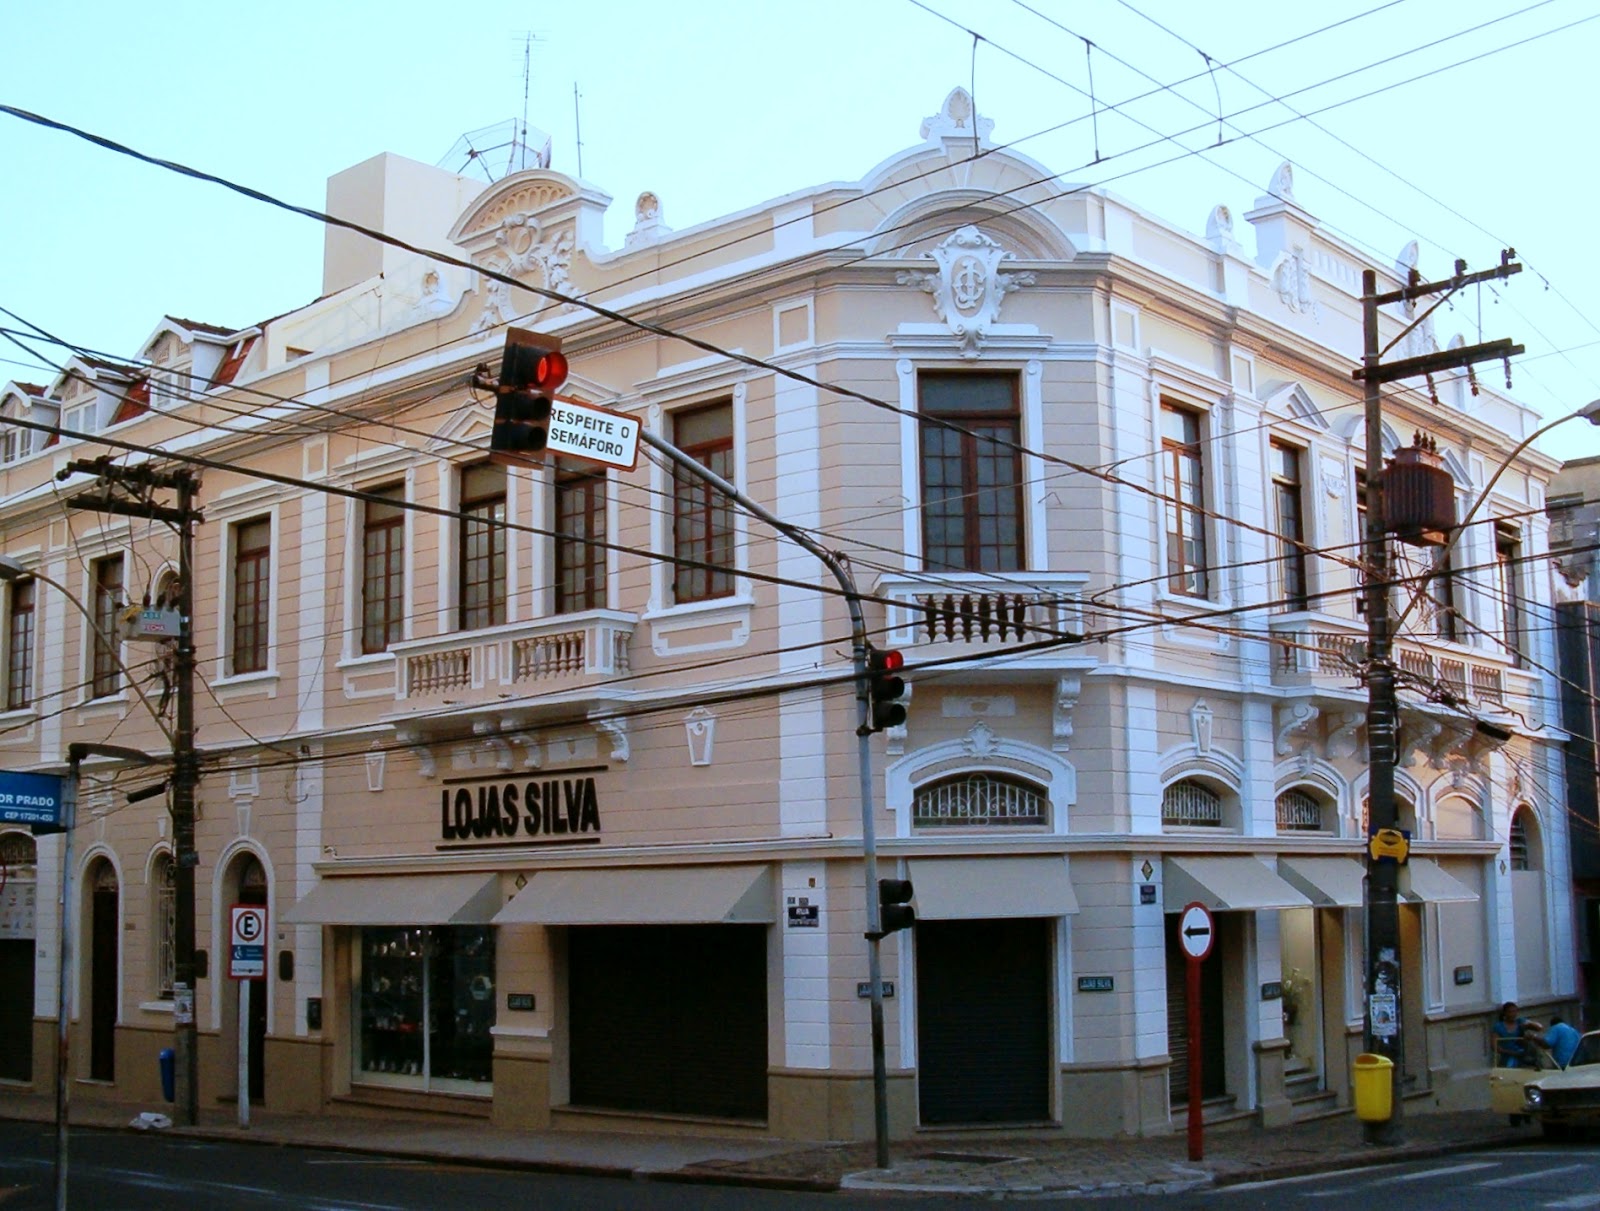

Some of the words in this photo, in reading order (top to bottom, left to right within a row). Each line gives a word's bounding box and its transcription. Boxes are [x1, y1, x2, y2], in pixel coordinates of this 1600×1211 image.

[550, 408, 614, 435] RESPEITE
[621, 426, 630, 439] O
[550, 428, 623, 456] SEMÁFORO
[16, 795, 54, 807] PRADO
[442, 783, 519, 839] LOJAS
[524, 777, 601, 836] SILVA
[4, 811, 19, 820] CEP
[244, 916, 254, 935] E
